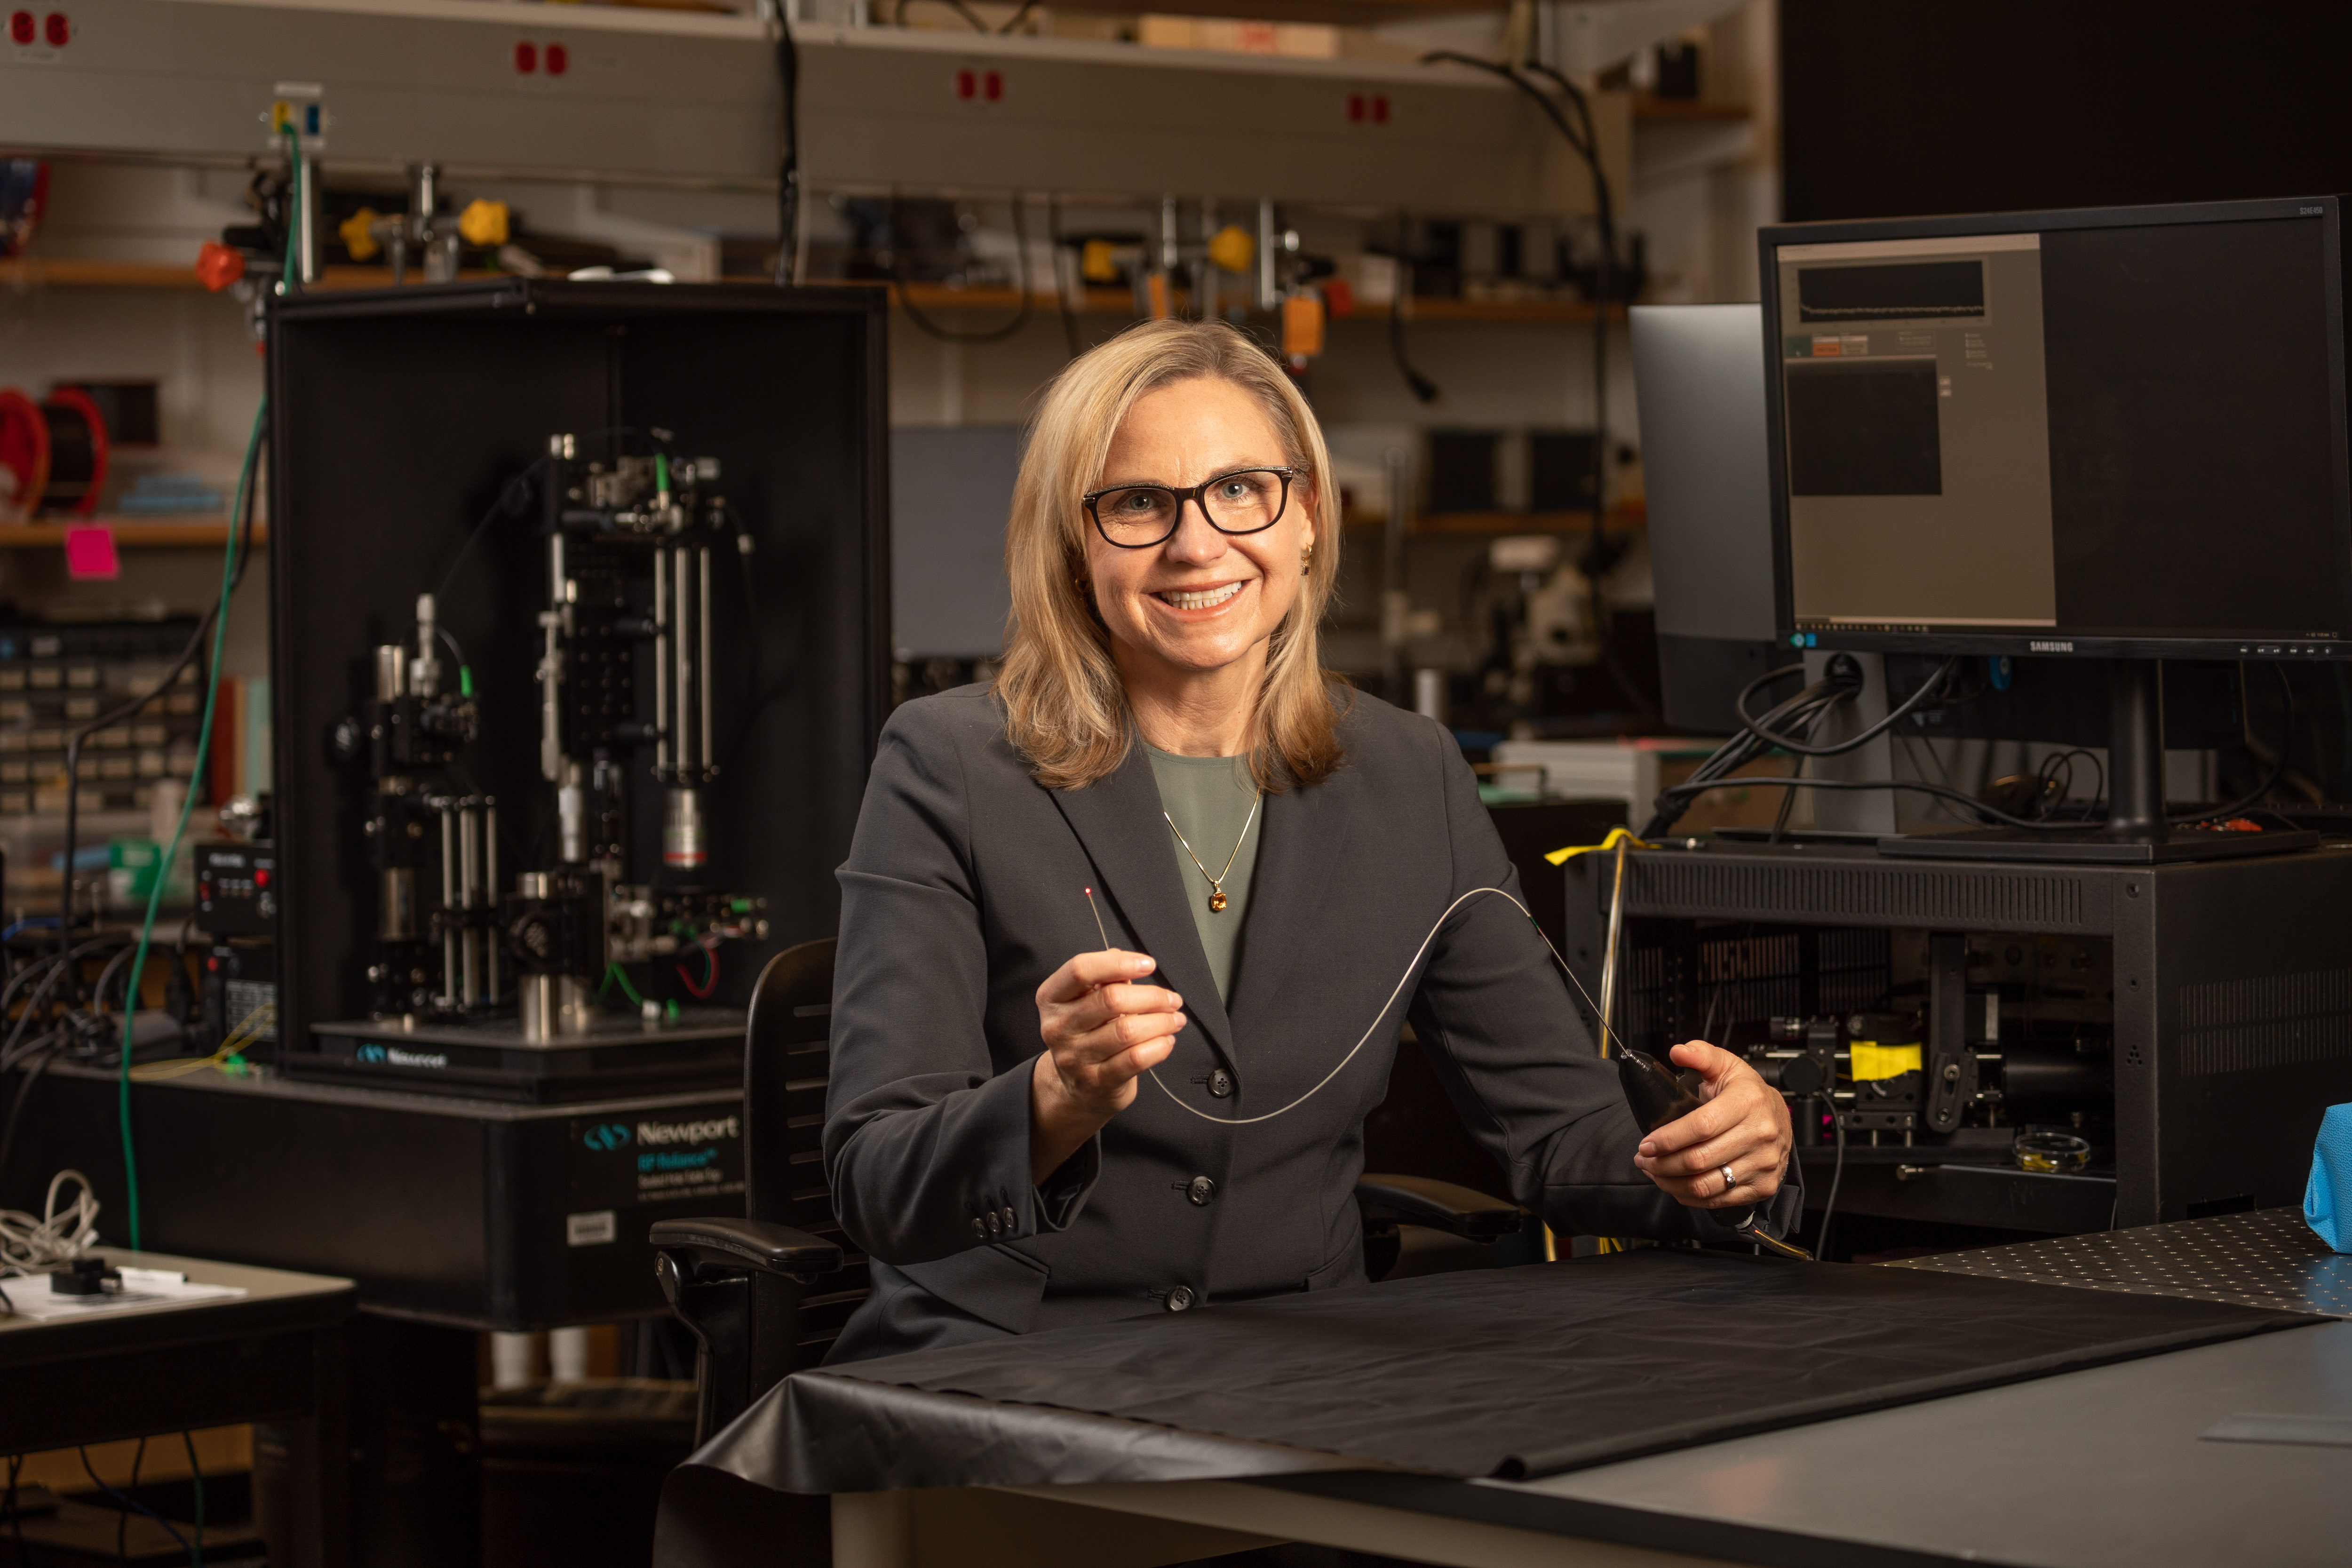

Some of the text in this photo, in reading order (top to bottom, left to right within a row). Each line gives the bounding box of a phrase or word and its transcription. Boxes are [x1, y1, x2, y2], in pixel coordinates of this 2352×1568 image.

[2030, 641, 2073, 653] SAMSUNG
[387, 1047, 448, 1068] Newport
[637, 1115, 739, 1146] Newport
